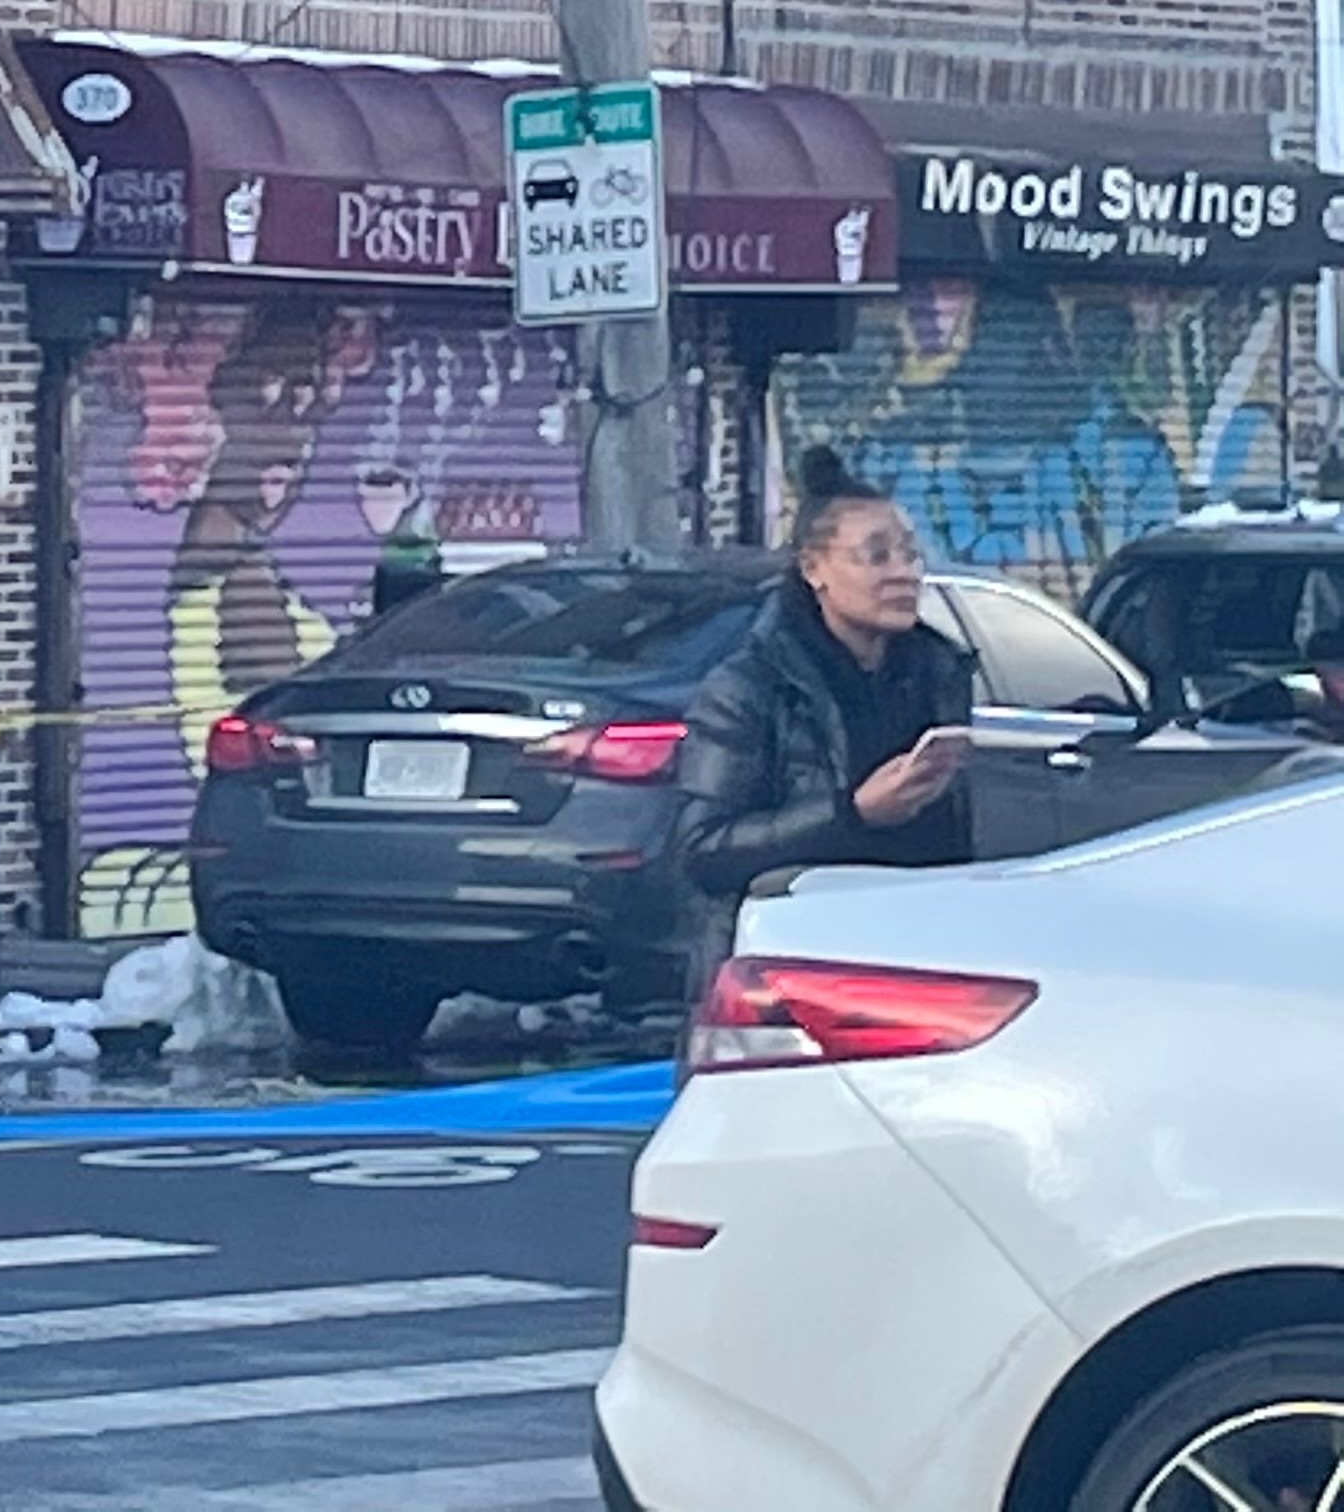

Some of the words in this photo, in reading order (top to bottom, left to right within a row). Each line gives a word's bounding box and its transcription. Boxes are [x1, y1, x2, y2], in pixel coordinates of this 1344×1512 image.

[921, 158, 1083, 216] Mood
[1098, 164, 1296, 237] Swings
[337, 191, 482, 274] Pastry
[527, 217, 648, 256] SHARED
[548, 262, 628, 301] LANE
